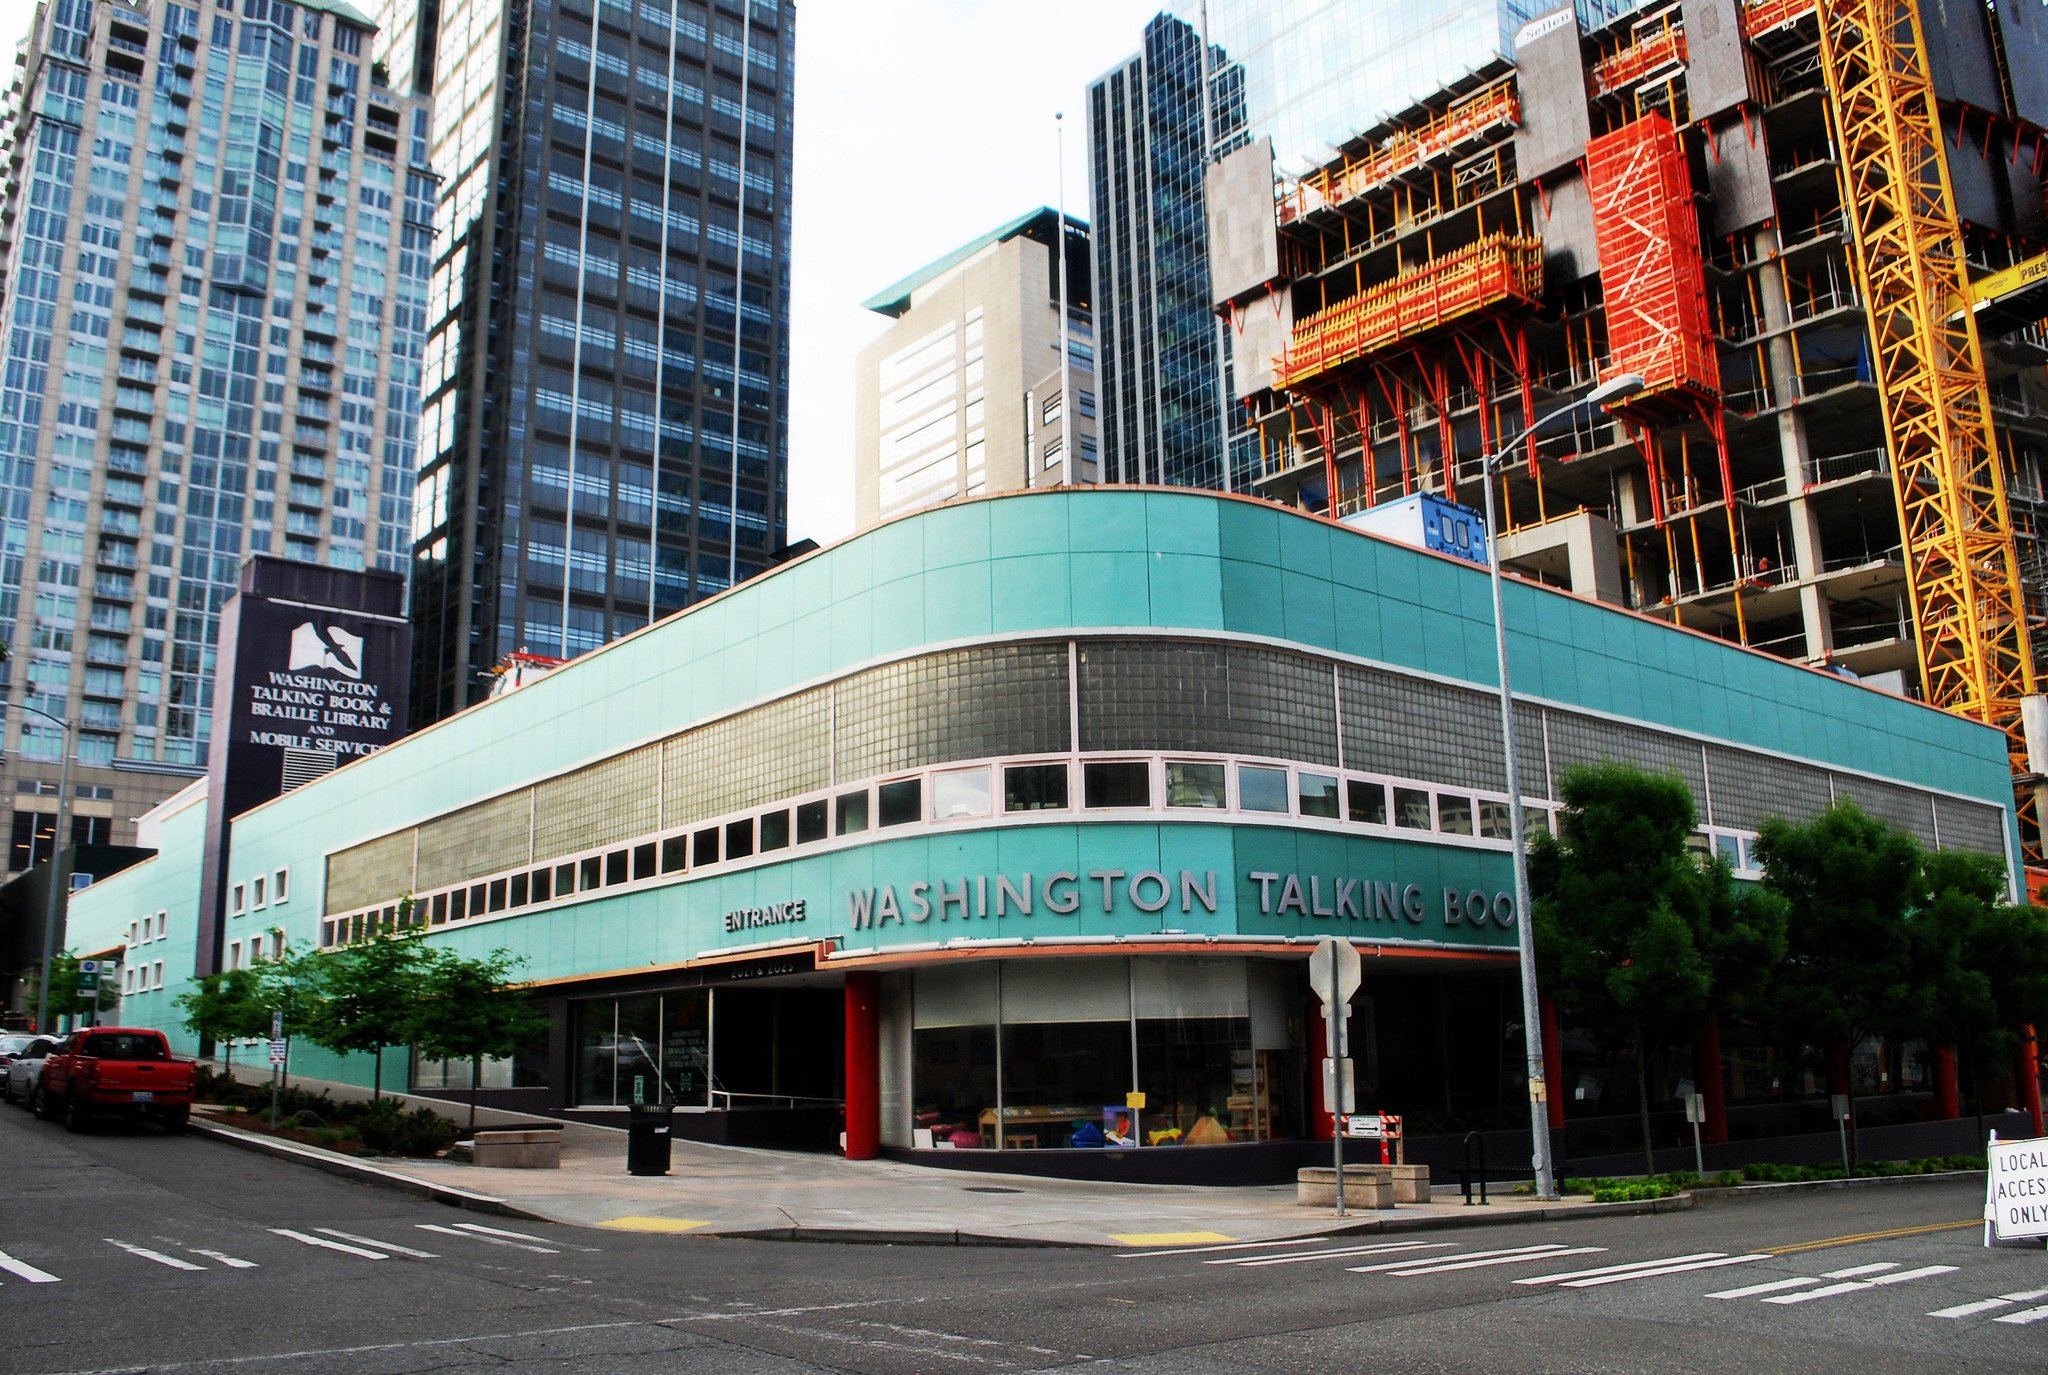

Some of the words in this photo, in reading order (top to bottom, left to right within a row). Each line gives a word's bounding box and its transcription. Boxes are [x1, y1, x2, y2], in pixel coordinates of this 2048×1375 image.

[1526, 13, 1569, 40] Sellen
[268, 671, 378, 697] WASHINGTON
[251, 685, 325, 706] TALKING
[329, 694, 375, 712] BOOK
[379, 701, 393, 715] &
[251, 702, 320, 722] BRAILLE
[323, 710, 391, 730] LIBRARY
[250, 731, 312, 750] MOBILE
[308, 725, 335, 736] AND
[846, 870, 1217, 929] WASHINGTON
[1249, 871, 1426, 923] TALKING
[724, 898, 806, 933] ENTRANCE
[2000, 1151, 2048, 1172] LOCAL
[1998, 1177, 2048, 1199] ACCES
[2010, 1204, 2048, 1225] ONLY
